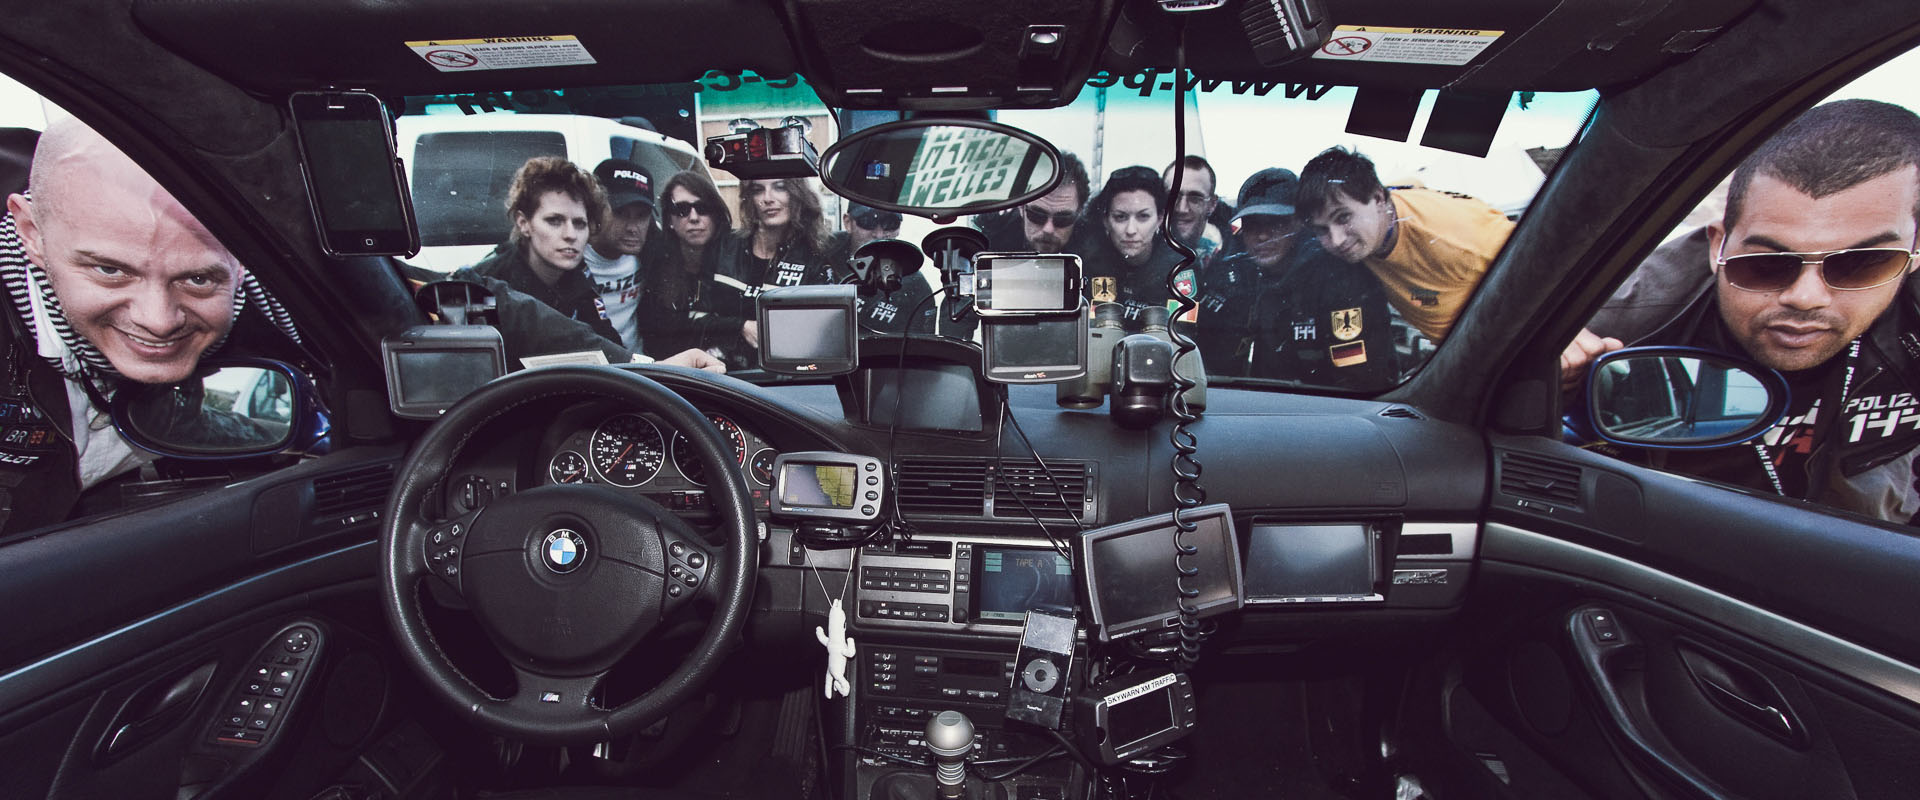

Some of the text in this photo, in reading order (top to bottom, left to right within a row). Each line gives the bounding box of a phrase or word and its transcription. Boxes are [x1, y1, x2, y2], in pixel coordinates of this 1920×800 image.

[1411, 28, 1481, 36] WARNING
[482, 36, 553, 44] WARNING
[777, 260, 806, 272] POLIZEI
[775, 270, 804, 286] 144
[870, 307, 897, 324] 144
[547, 530, 582, 546] BMW
[1015, 558, 1043, 568] TAPE A
[1107, 674, 1175, 705] SKYWARN XM TRAFFIC
